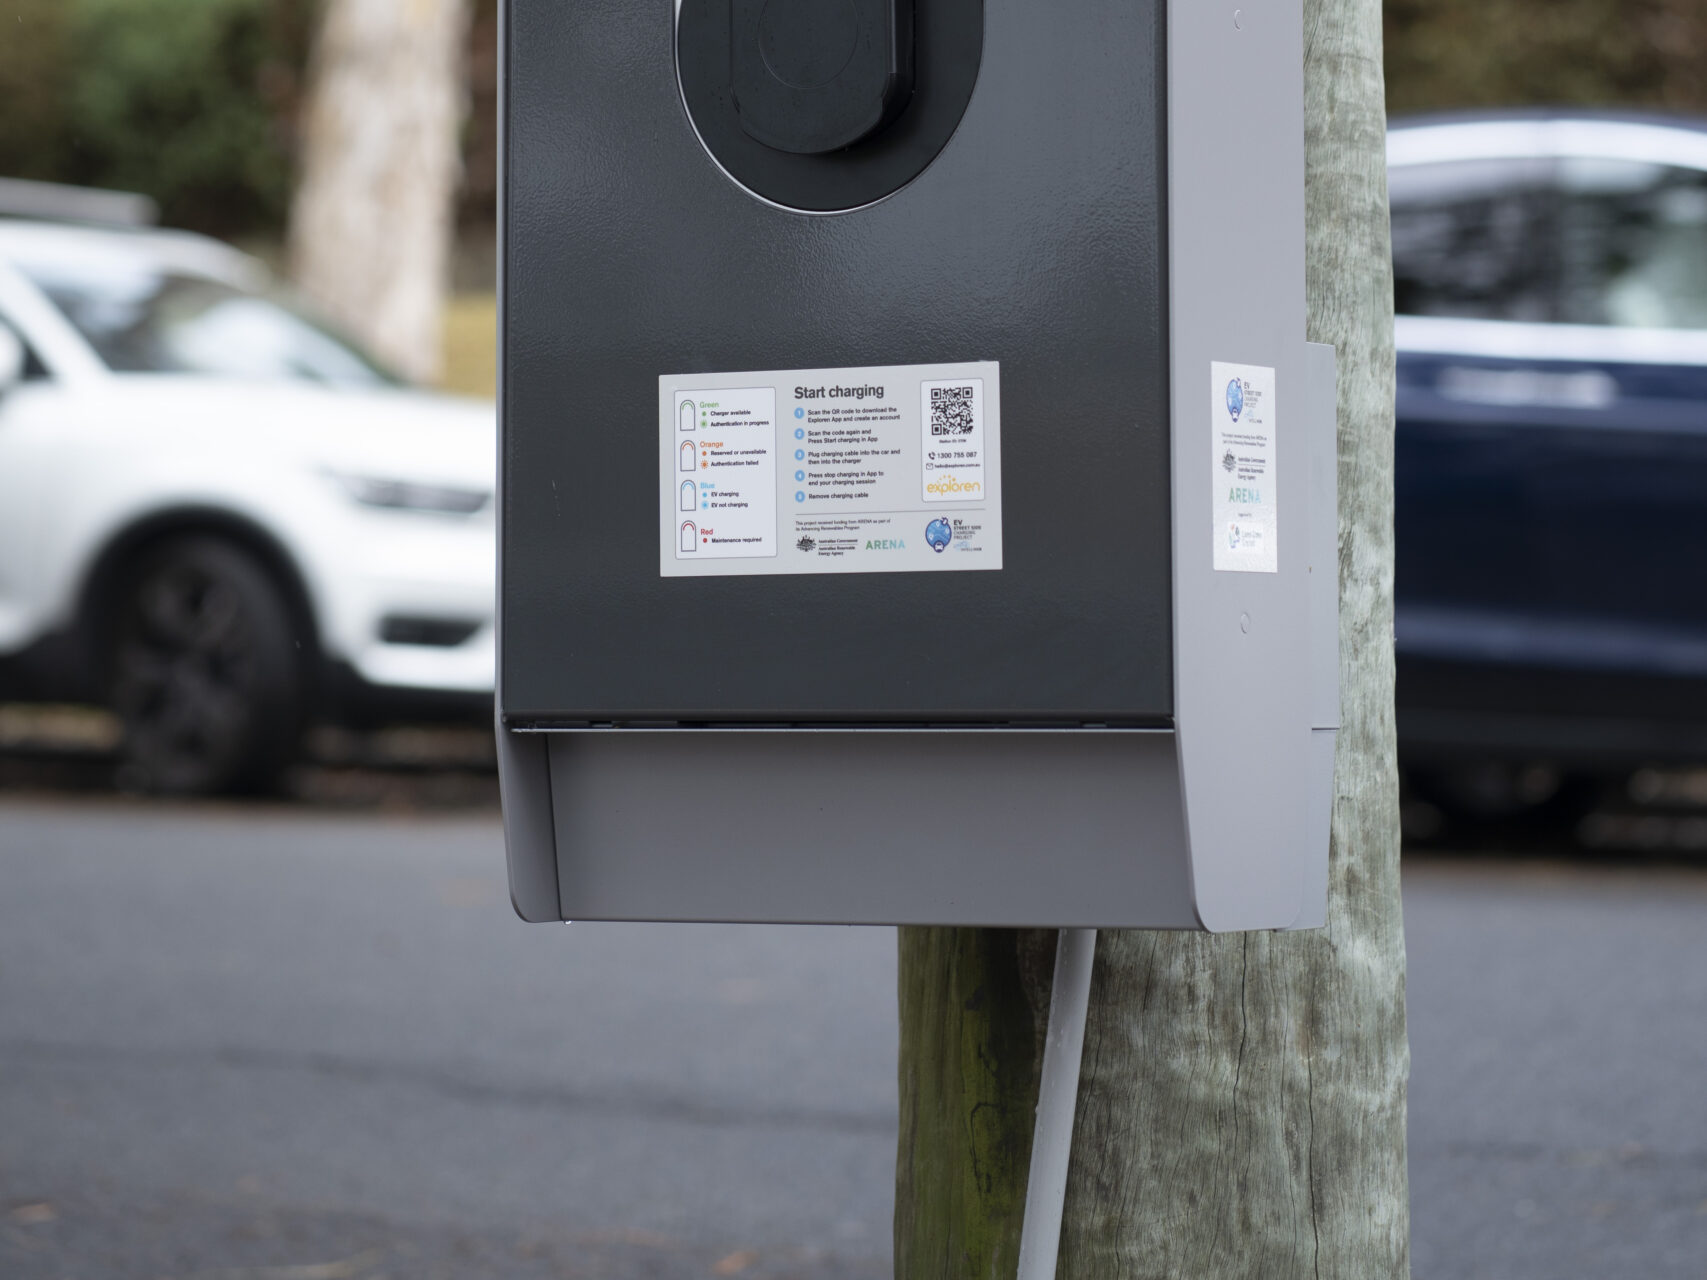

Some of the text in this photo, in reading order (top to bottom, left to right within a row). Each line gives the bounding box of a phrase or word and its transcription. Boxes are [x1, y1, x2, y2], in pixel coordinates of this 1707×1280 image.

[795, 384, 884, 399] Start charging
[927, 480, 981, 496] exploren
[1229, 488, 1262, 504] ARENA
[866, 539, 906, 550] ARENA
